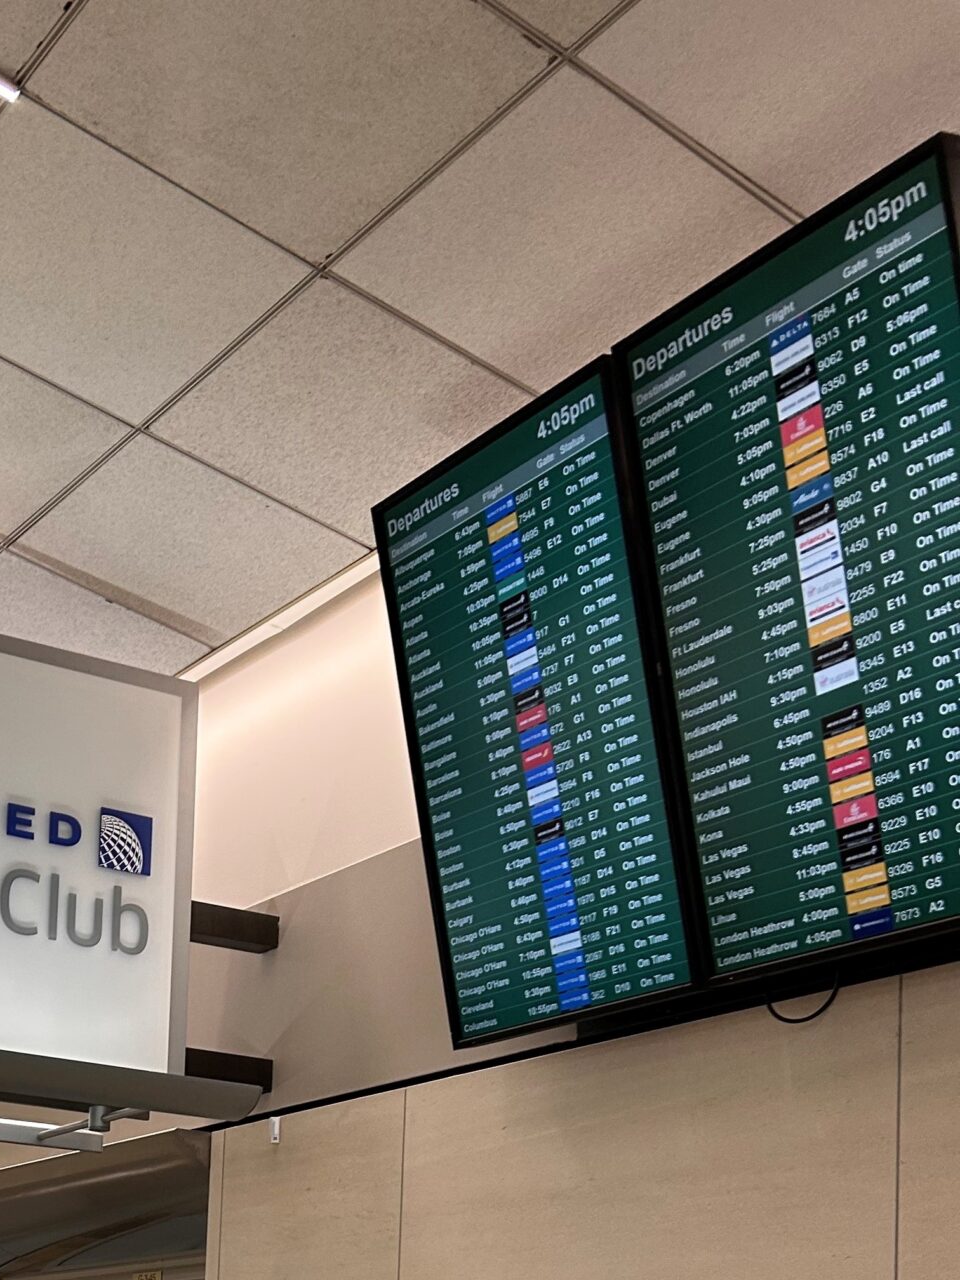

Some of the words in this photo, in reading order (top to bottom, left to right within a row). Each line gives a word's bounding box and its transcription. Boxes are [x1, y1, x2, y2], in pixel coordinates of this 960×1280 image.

[631, 305, 733, 380] Departures
[843, 180, 927, 242] 4:05pm
[720, 332, 746, 352] Time
[764, 300, 795, 327] Flight
[841, 257, 868, 279] Gate
[874, 230, 912, 259] Status
[723, 349, 761, 377] 6:20pm
[777, 317, 809, 345] DELTA
[809, 302, 837, 326] 7684
[843, 286, 860, 306] A5
[878, 267, 897, 285] On
[896, 252, 923, 274] time
[727, 368, 769, 398] 11:05pm
[813, 325, 840, 349] 6313
[846, 307, 869, 329] F12
[881, 291, 900, 309] On
[899, 274, 930, 297] Time
[730, 394, 767, 420] 4:22pm
[816, 348, 844, 372] 9062
[849, 334, 867, 353] D9
[885, 302, 929, 333] 5:06pm
[732, 416, 770, 444] 7:03pm
[819, 372, 847, 395] 6350
[852, 357, 870, 376] E5
[888, 340, 908, 357] On
[907, 323, 938, 346] Time
[736, 439, 773, 465] 5:05pm
[823, 399, 844, 419] 226
[856, 381, 873, 400] A6
[891, 364, 911, 380] On
[910, 348, 941, 370] Time
[738, 461, 776, 487] 4:10pm
[825, 419, 853, 442] 7716
[859, 406, 876, 423] E2
[894, 382, 923, 405] Last
[922, 369, 945, 391] call
[386, 482, 460, 537] Departures
[536, 392, 595, 439] 4:05pm
[481, 482, 504, 503] Flight
[535, 452, 555, 469] Gate
[558, 433, 585, 455] Status
[561, 462, 575, 476] On
[574, 450, 596, 468] Time
[564, 483, 578, 496] On
[577, 470, 599, 488] Time
[741, 484, 779, 510] 9:05pm
[829, 442, 856, 465] 8574
[862, 426, 885, 447] F18
[898, 413, 918, 428] On
[917, 397, 948, 419] Time
[745, 506, 783, 531] 4:30pm
[832, 465, 859, 488] 8837
[866, 450, 889, 471] A10
[901, 431, 929, 454] Last
[928, 419, 952, 440] call
[570, 523, 584, 536] On
[583, 511, 605, 529] Time
[747, 529, 786, 554] 7:25pm
[835, 489, 863, 511] 9802
[869, 476, 887, 493] G4
[905, 461, 924, 477] On
[923, 446, 955, 467] Time
[750, 551, 789, 576] 5:25pm
[839, 512, 866, 535] 2034
[872, 500, 888, 518] F7
[908, 485, 928, 501] On
[927, 471, 958, 491] Time
[753, 574, 792, 598] 7:50pm
[842, 536, 869, 557] 1450
[875, 521, 898, 541] F10
[911, 509, 931, 525] On
[756, 596, 795, 620] 9:03pm
[845, 559, 873, 581] 8479
[879, 548, 896, 564] E9
[914, 533, 934, 549] On
[584, 622, 599, 635] On
[597, 612, 620, 629] Time
[587, 642, 602, 655] On
[601, 632, 623, 649] Time
[760, 618, 798, 641] 4:45pm
[849, 582, 876, 604] 2255
[882, 569, 905, 588] F22
[918, 557, 938, 572] On
[762, 641, 801, 664] 7:10pm
[852, 606, 879, 627] 8800
[885, 592, 907, 611] E11
[921, 581, 941, 596] On
[766, 663, 804, 685] 4:15pm
[855, 629, 882, 650] 9200
[888, 618, 906, 635] E5
[775, 729, 813, 750] 4:50pm
[866, 699, 892, 718] 9489
[898, 686, 922, 705] D16
[788, 818, 826, 837] 4:33pm
[879, 791, 905, 809] 6366
[911, 780, 934, 798] E10
[804, 928, 842, 944] 4:05pm
[896, 906, 921, 921] 7673
[928, 898, 945, 913] A2
